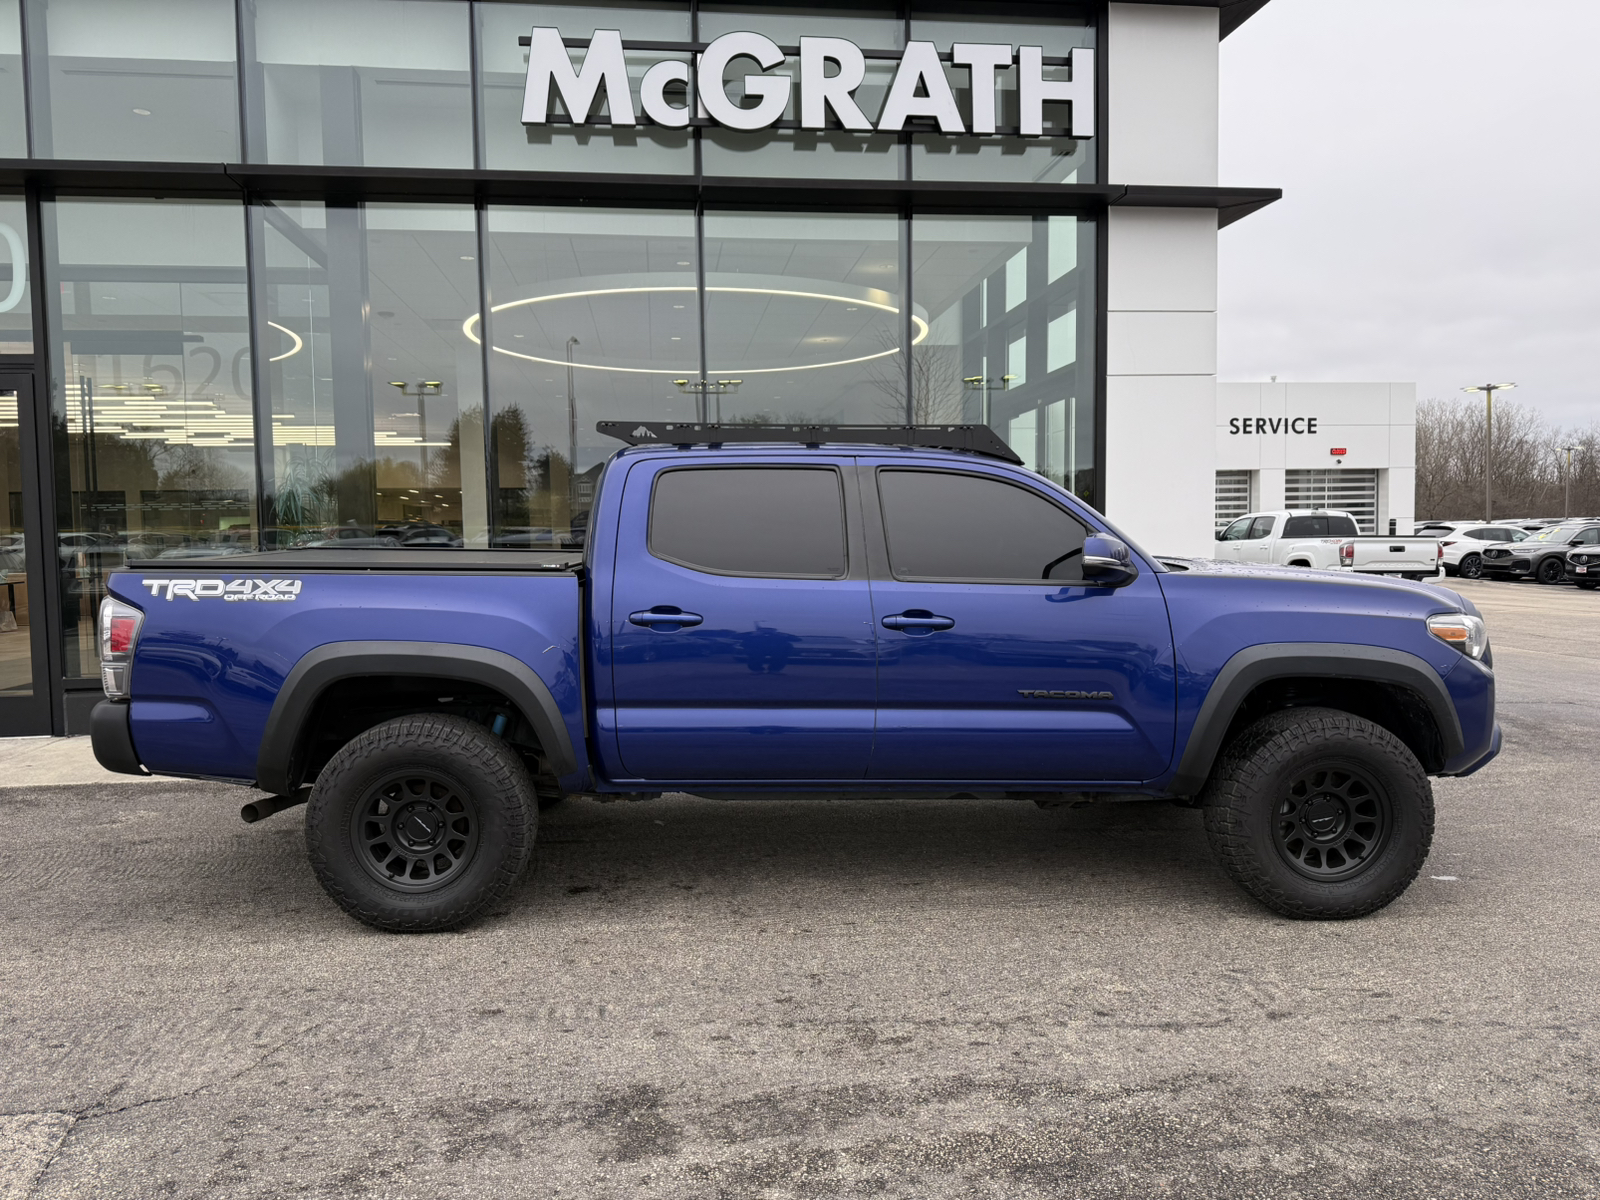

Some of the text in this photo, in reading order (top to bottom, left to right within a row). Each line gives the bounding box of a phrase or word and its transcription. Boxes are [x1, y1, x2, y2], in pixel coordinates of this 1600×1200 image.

[521, 26, 1095, 139] McGRATH
[1229, 417, 1318, 435] SERVICE
[1017, 689, 1115, 700] TACOMA
